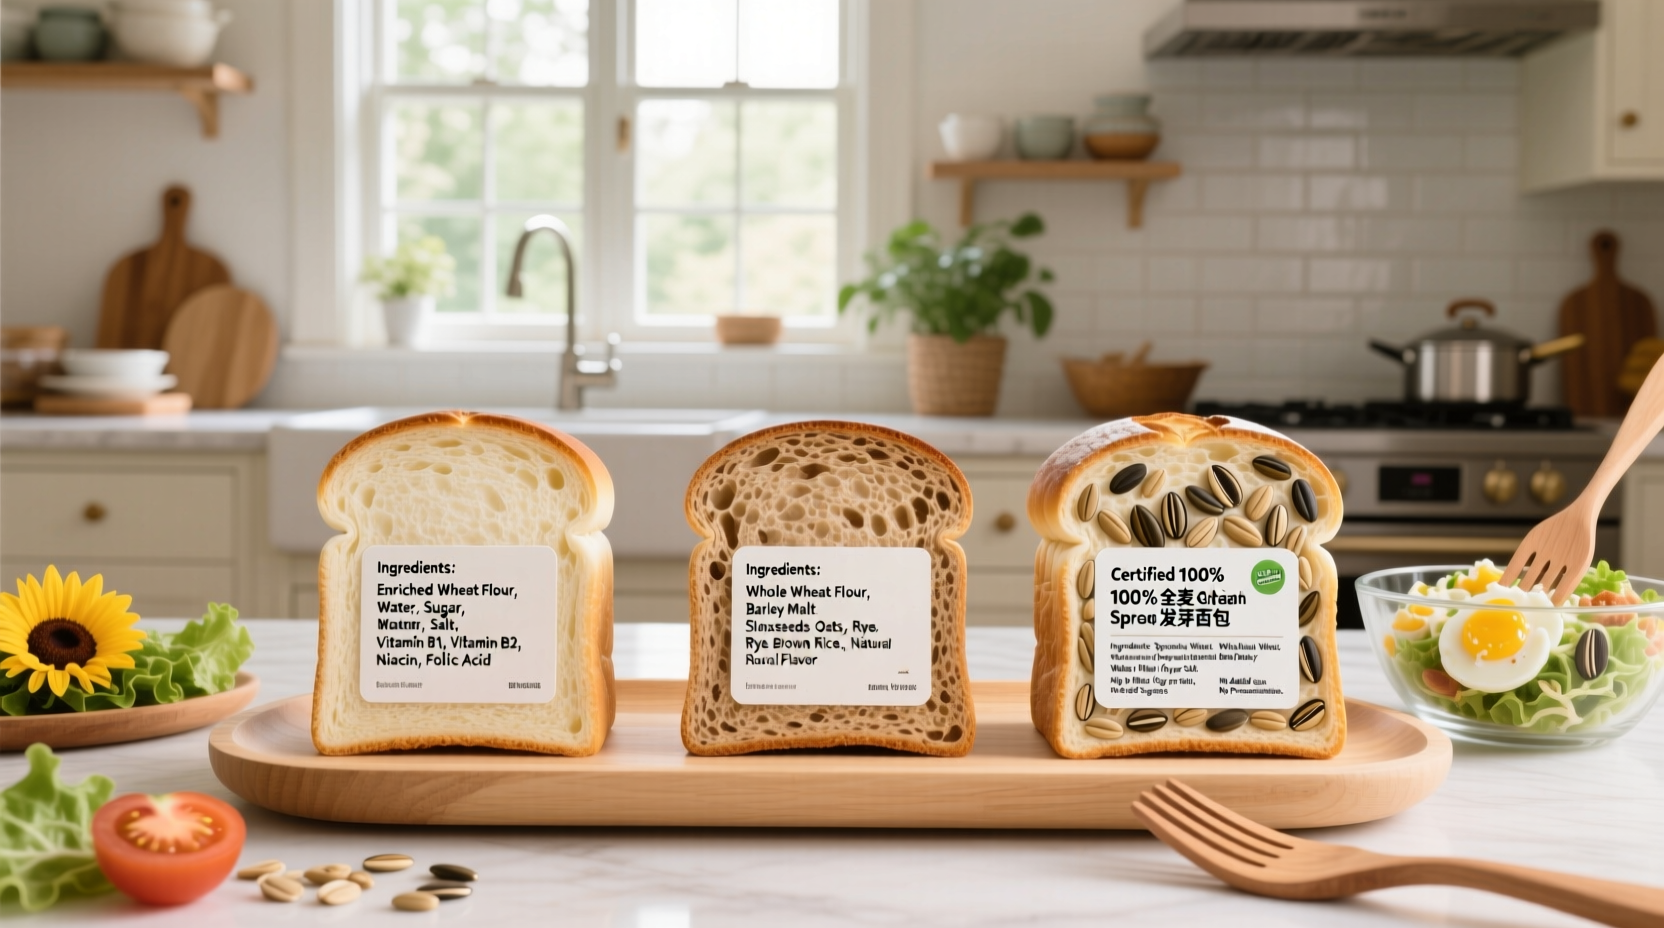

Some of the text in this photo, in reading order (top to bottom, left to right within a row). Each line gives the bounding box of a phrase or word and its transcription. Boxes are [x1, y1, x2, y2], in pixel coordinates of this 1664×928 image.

[378, 560, 455, 577] Ingredients:
[747, 562, 820, 578] Ingredients:
[1111, 566, 1224, 582] Certified 100%
[377, 583, 433, 596] Enriched
[482, 583, 517, 599] Flour,
[746, 585, 870, 601] Whole Wheat Flour,
[1110, 589, 1158, 605] 100%
[1160, 588, 1194, 606] 全麦
[424, 601, 464, 618] Sugar,
[746, 602, 784, 618] Barley
[377, 635, 424, 648] Vitamin
[428, 636, 446, 650] B1,
[501, 636, 521, 652] B2,
[746, 637, 768, 653] Rye
[377, 651, 491, 669] Niacin, Folic Acid
